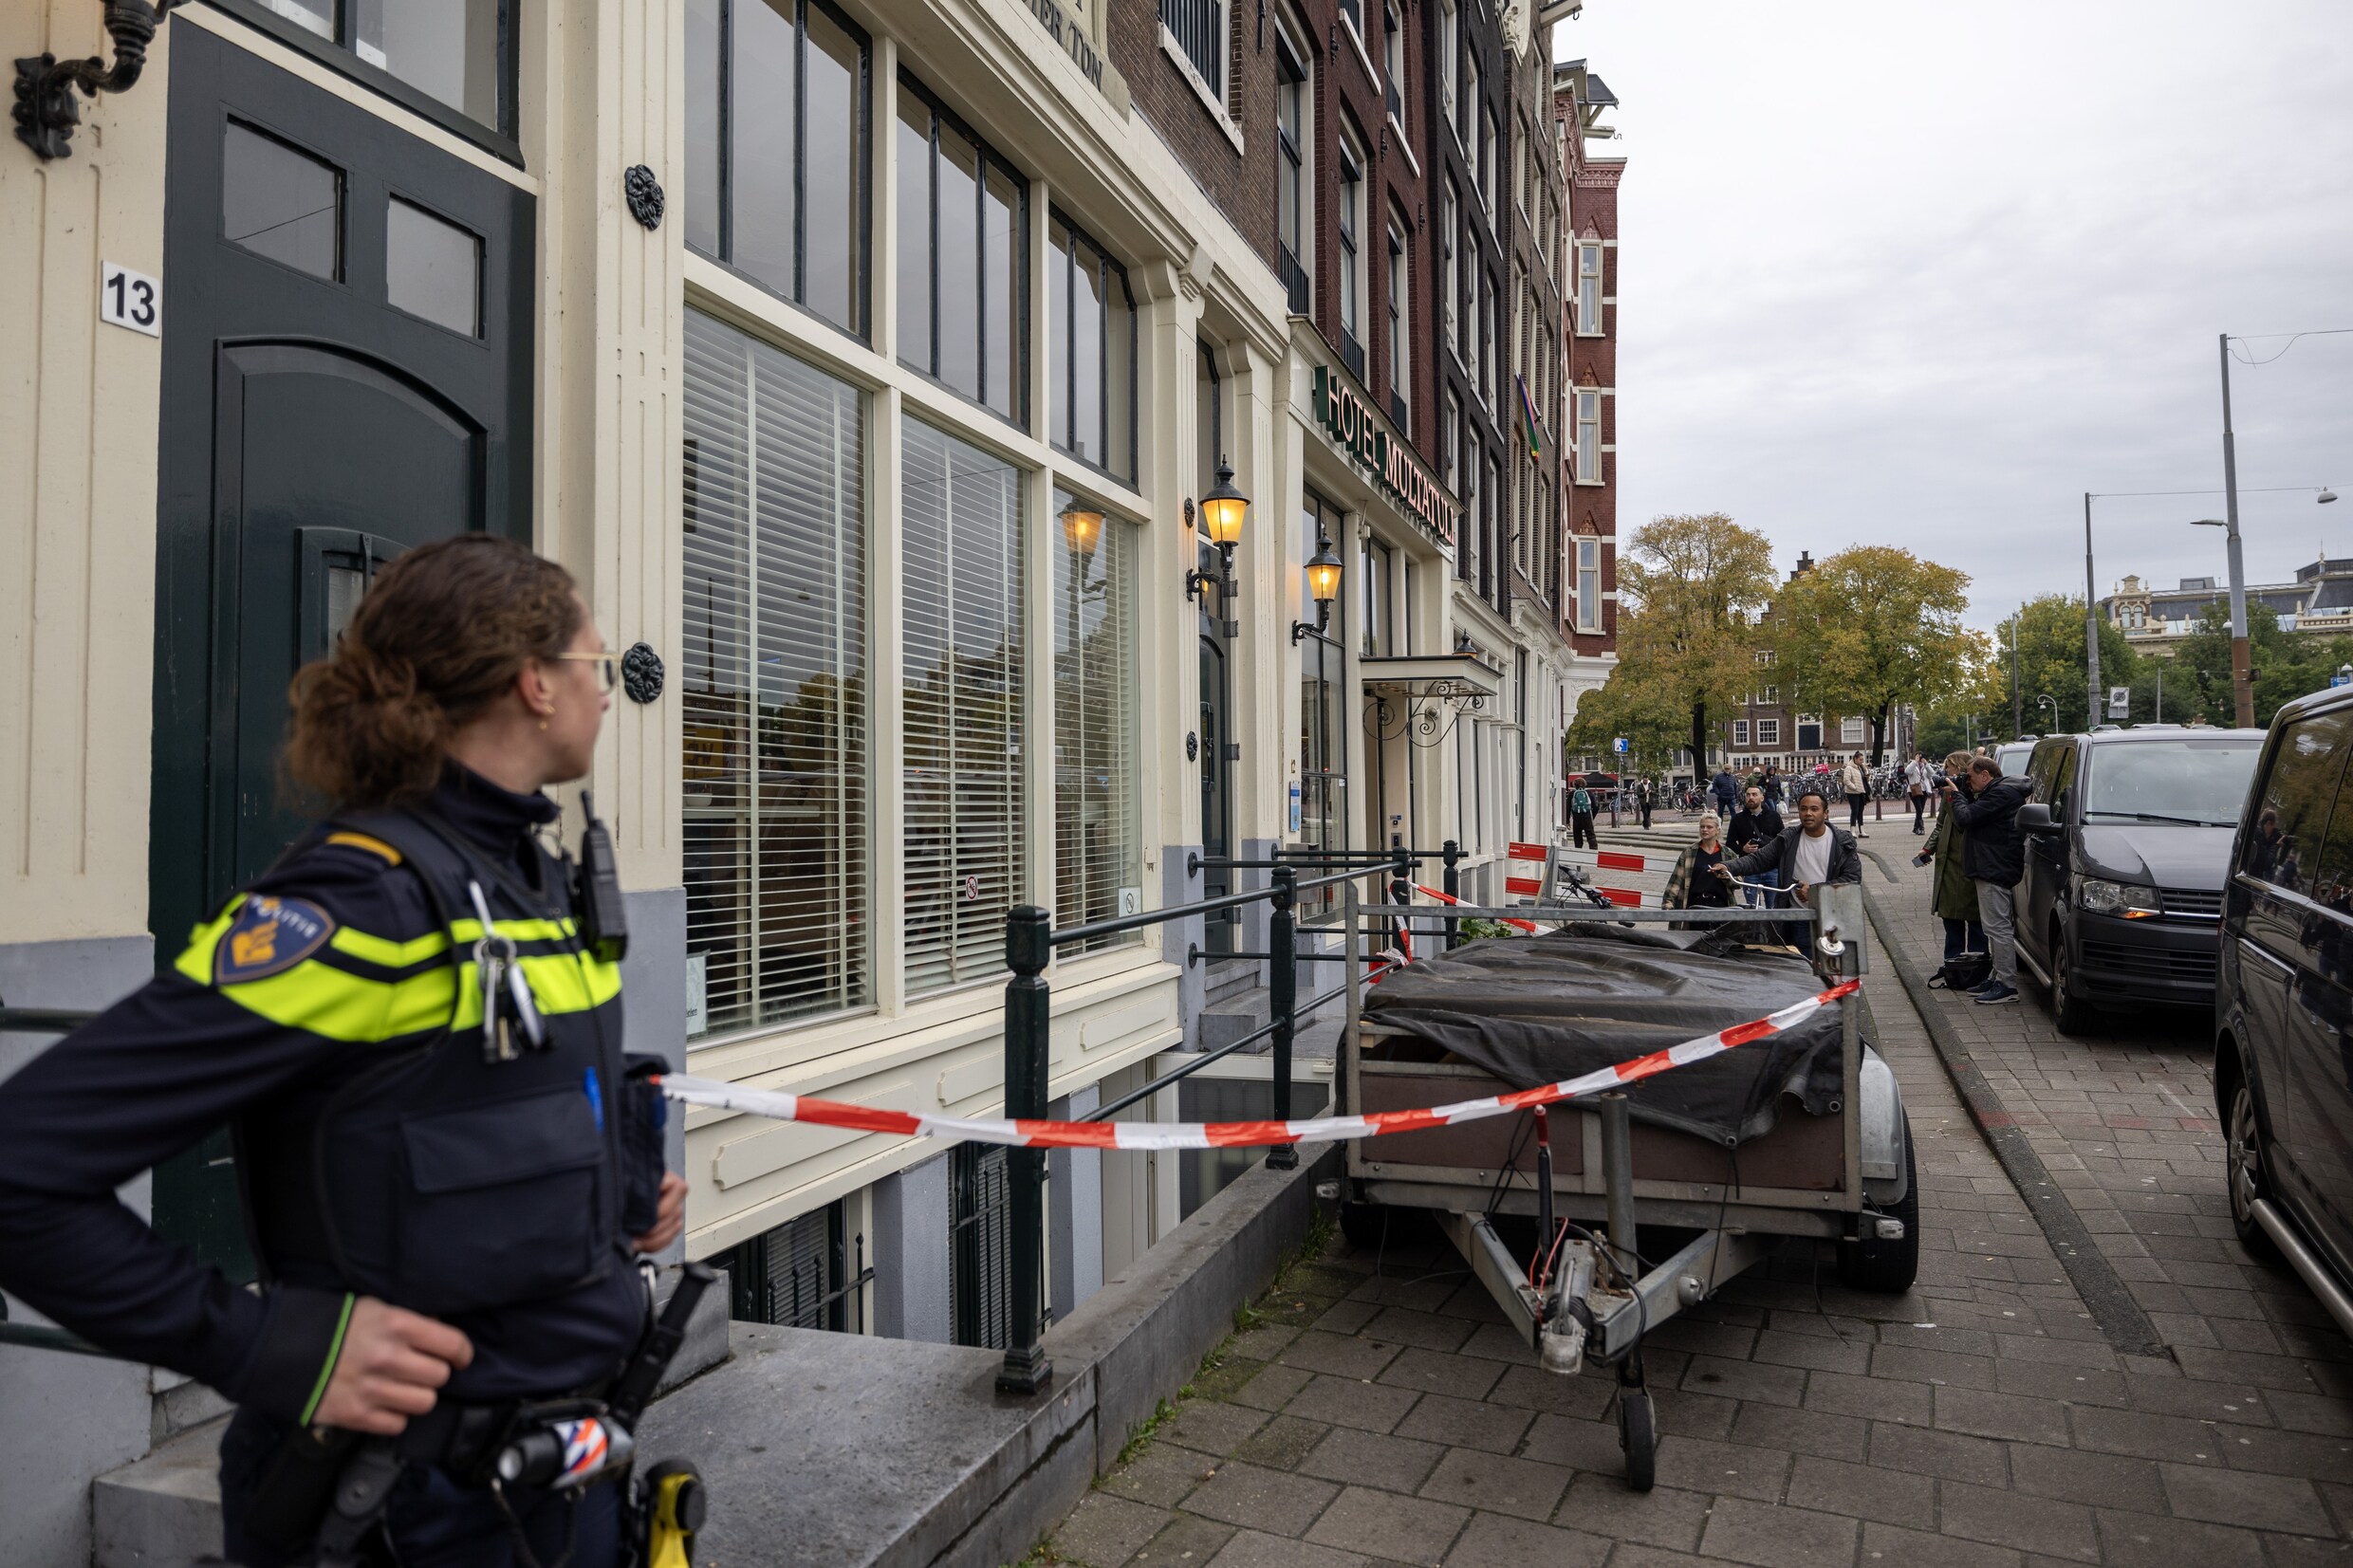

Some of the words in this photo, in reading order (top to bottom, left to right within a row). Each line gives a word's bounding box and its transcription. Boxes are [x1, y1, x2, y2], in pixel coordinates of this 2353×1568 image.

[1068, 21, 1103, 93] TON
[107, 271, 156, 327] 13
[1326, 365, 1380, 471] HOTEL
[1384, 432, 1455, 546] MULTATULI
